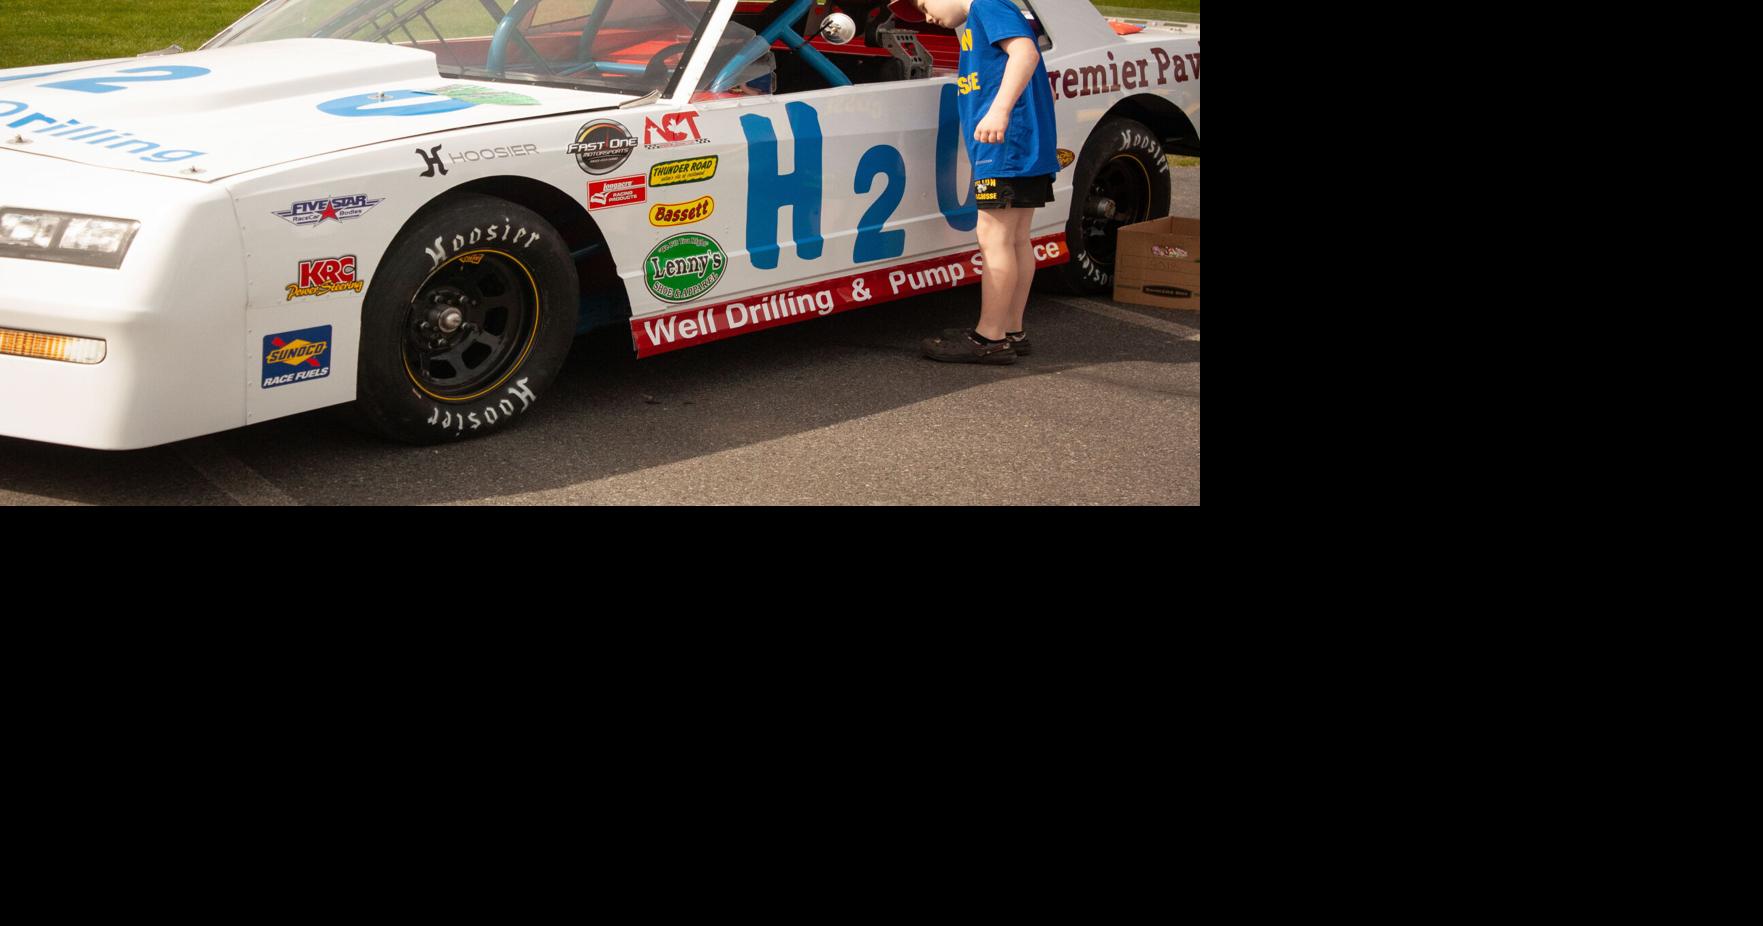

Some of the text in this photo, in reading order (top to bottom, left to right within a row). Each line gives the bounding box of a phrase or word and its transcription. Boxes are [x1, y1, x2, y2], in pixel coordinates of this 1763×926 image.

[1047, 42, 1200, 100] remier Pav
[449, 143, 540, 165] HOOSIER
[567, 141, 605, 154] FAST
[653, 163, 690, 177] THUNDER
[690, 160, 713, 172] ROAD
[291, 194, 368, 215] FIVE STAR
[655, 200, 709, 222] Bassett
[425, 217, 540, 270] Hoosier
[299, 255, 357, 288] KRC
[651, 249, 723, 280] Lenny's
[285, 280, 364, 301] Power Steering
[653, 272, 719, 298] SHOE & APPAREL
[644, 262, 965, 346] Well Drilling & Pump
[268, 343, 325, 361] SUNOCO
[263, 367, 329, 387] RACE FUELS
[428, 377, 536, 437] Hoosier
